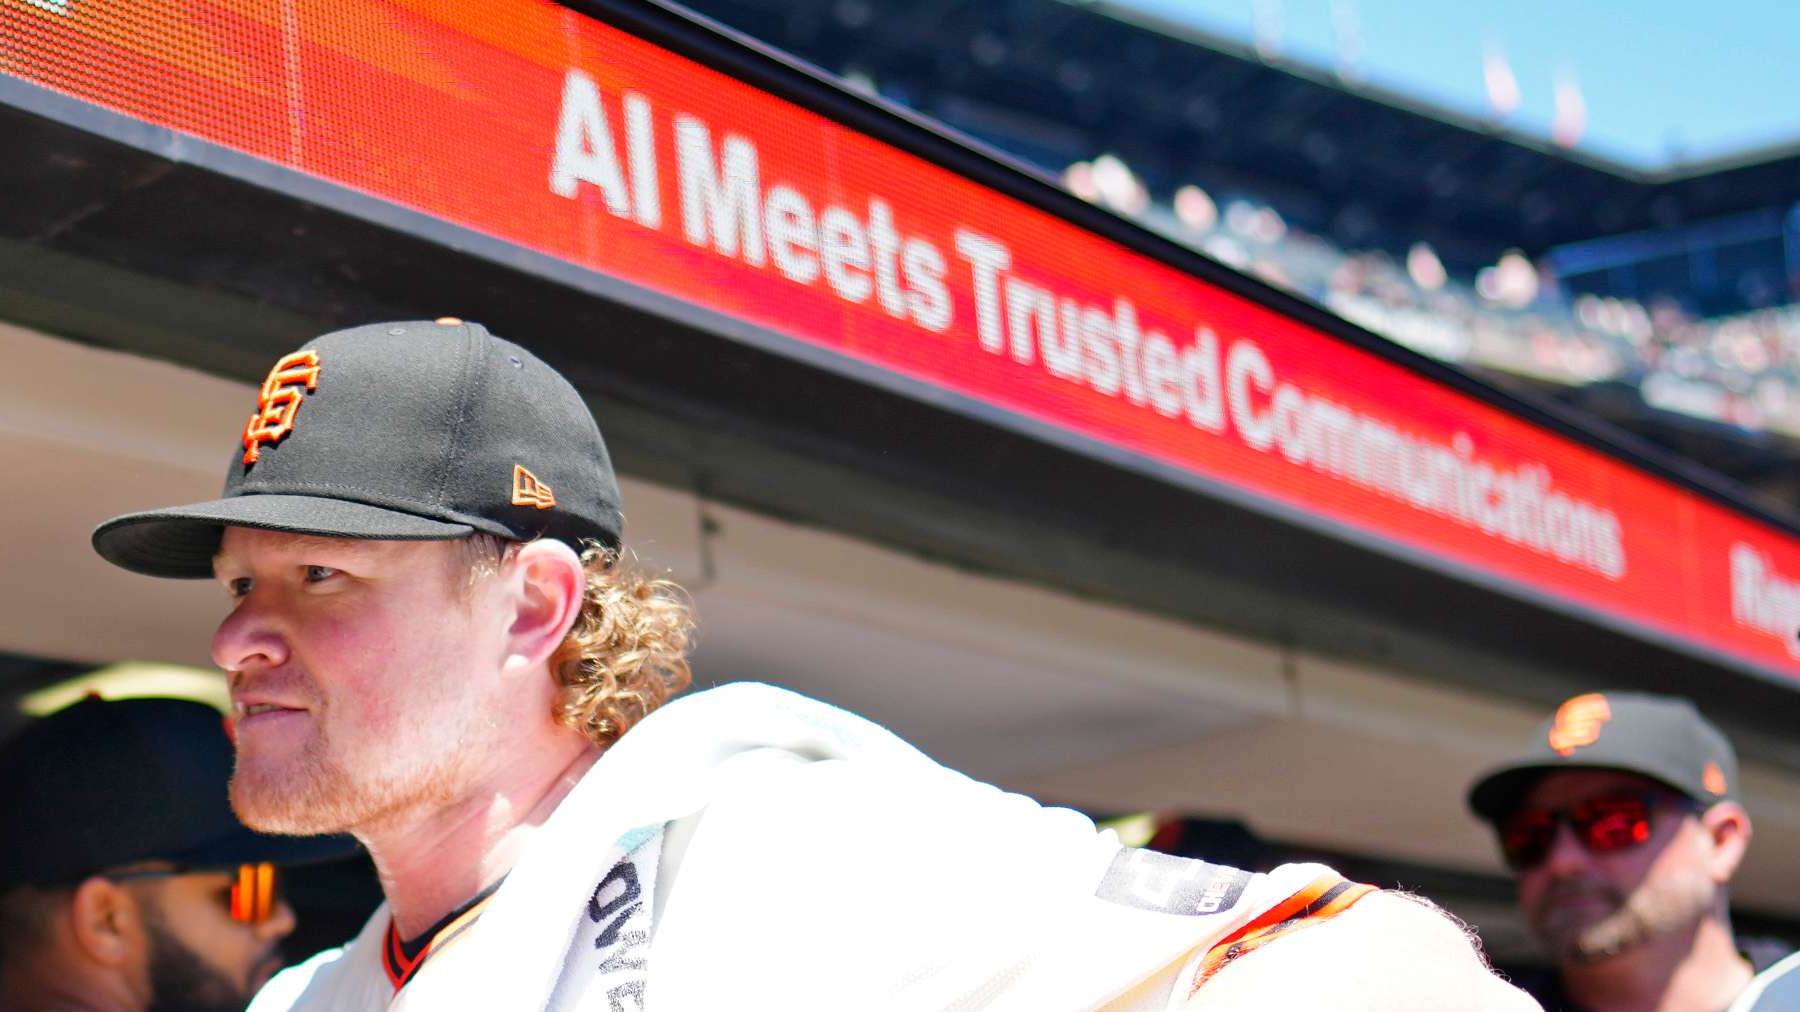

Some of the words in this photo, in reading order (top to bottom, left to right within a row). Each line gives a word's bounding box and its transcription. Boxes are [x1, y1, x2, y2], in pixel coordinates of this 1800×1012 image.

[549, 69, 661, 230] AI
[672, 112, 953, 332] Meets
[955, 228, 1227, 435] Trusted
[1225, 338, 1627, 582] Communications
